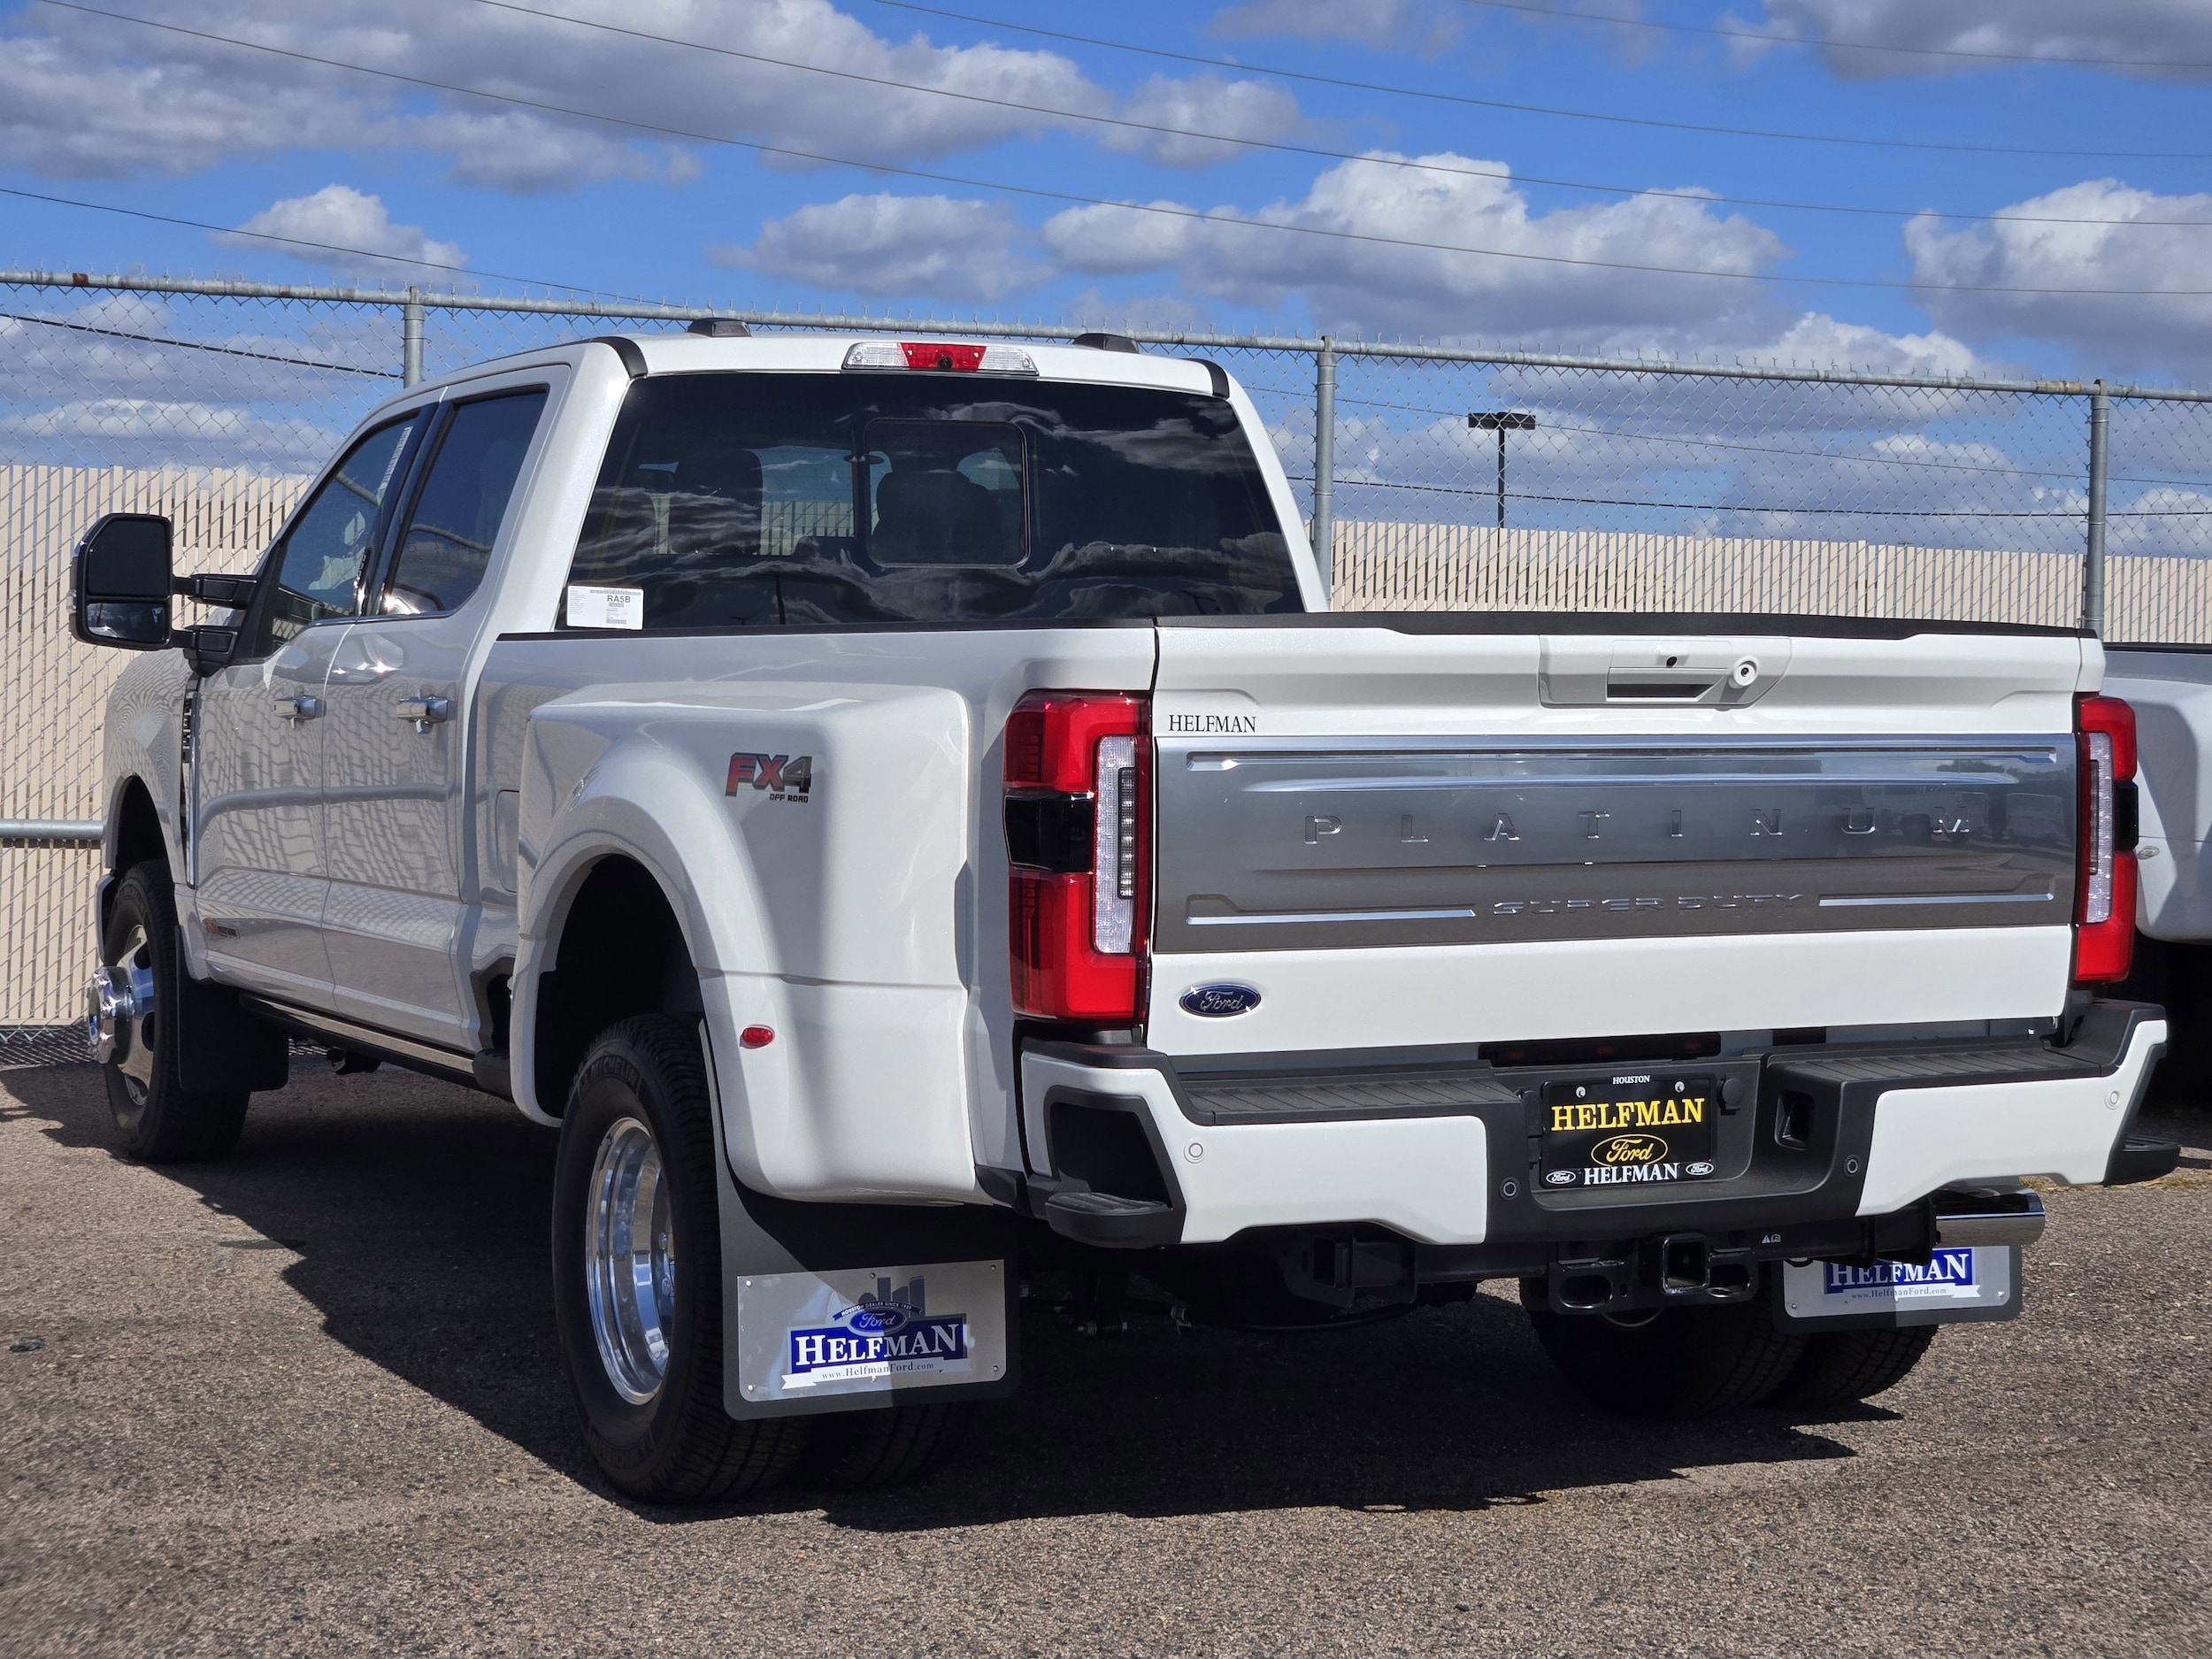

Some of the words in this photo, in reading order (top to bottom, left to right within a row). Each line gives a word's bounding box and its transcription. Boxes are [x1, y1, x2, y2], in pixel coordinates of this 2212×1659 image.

[607, 595, 631, 603] RA5B
[1168, 714, 1257, 733] HELFMAN
[725, 752, 813, 797] FX4
[787, 795, 809, 803] ROAD
[1303, 806, 1971, 845] PLATINUM
[1494, 897, 1664, 915] SUPER
[1678, 893, 1803, 911] DUTY
[1612, 1074, 1651, 1085] HOUSTON
[1550, 1097, 1706, 1132] HELFMAN
[1605, 1138, 1655, 1163] Ford
[1583, 1162, 1680, 1186] HELFMAN
[1830, 1253, 1970, 1286] HELFMAN
[1851, 1286, 1947, 1299] www.HelfmanFord.com
[858, 1312, 897, 1329] Ford
[795, 1323, 960, 1367] HELFMAN
[821, 1362, 935, 1379] www.HelfmanFord.com
